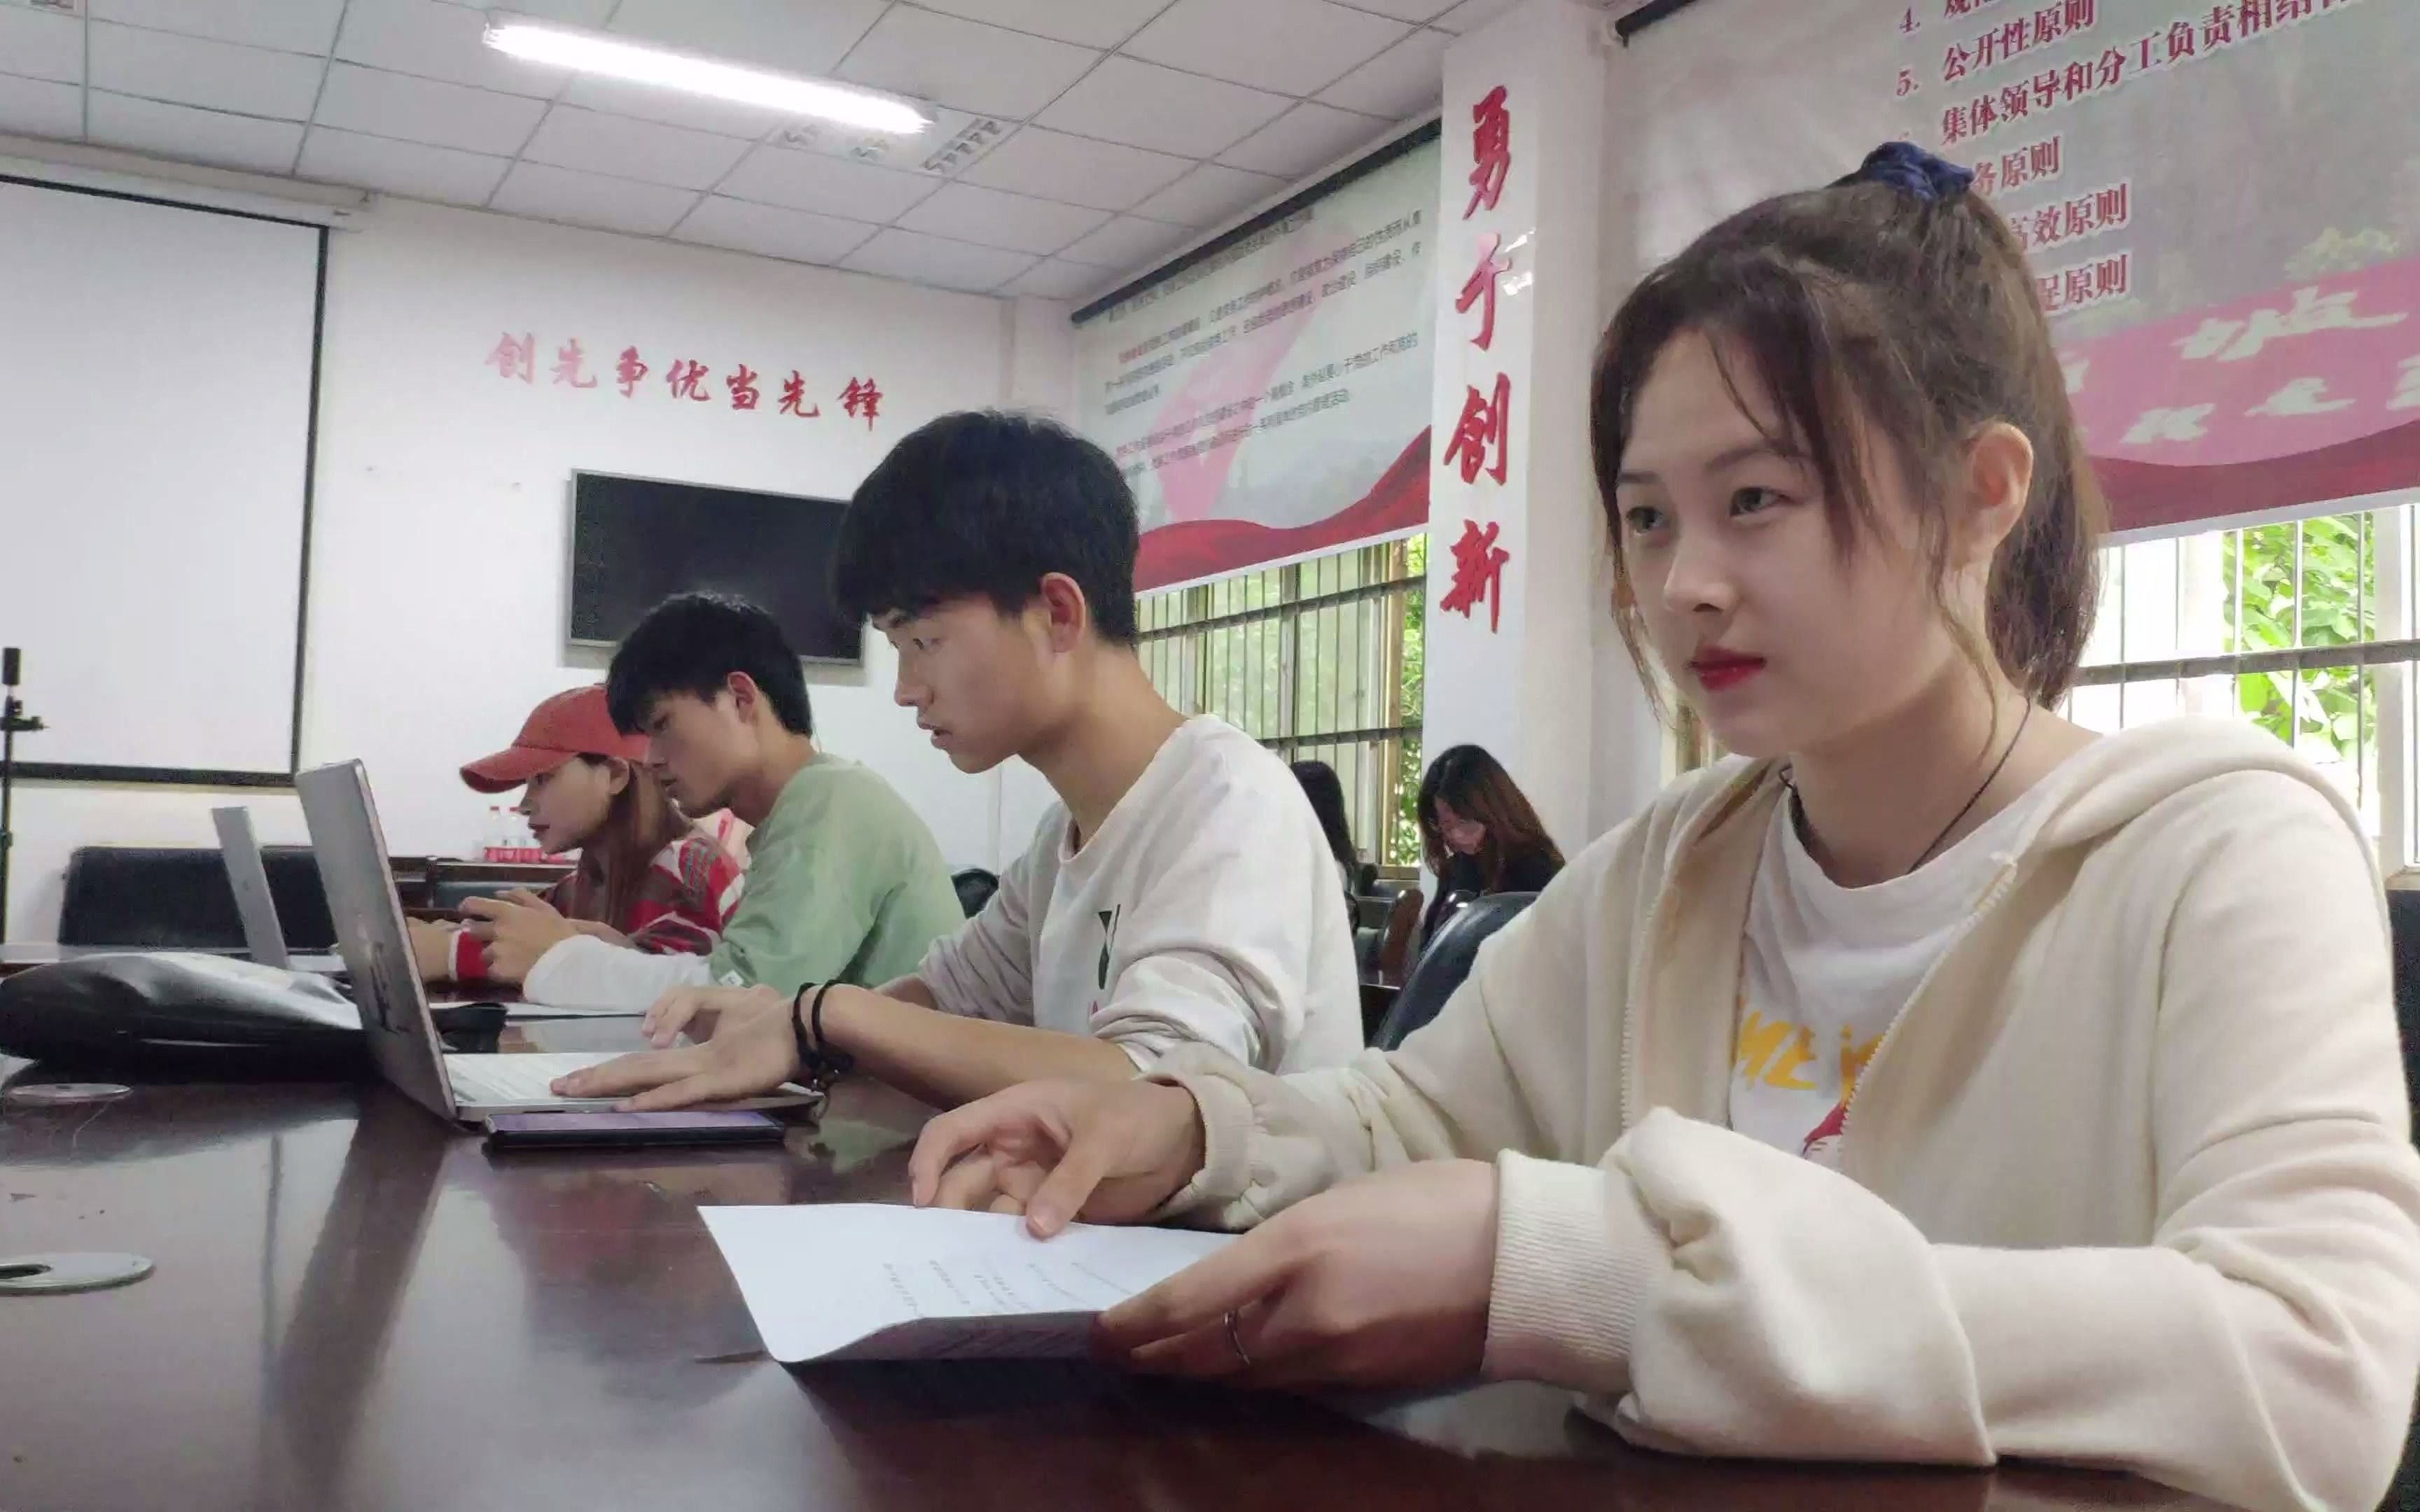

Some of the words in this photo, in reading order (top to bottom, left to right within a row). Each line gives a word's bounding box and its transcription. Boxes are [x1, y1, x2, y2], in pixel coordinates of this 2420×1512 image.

[1896, 69, 1919, 97] 5.
[1944, 0, 2094, 81] 公开性原则
[1899, 7, 1920, 34] 4.
[1941, 0, 2347, 145] 集体领导和分工负责相结
[485, 331, 884, 432] 创先争优当先锋
[1440, 85, 1512, 634] 勇于创新
